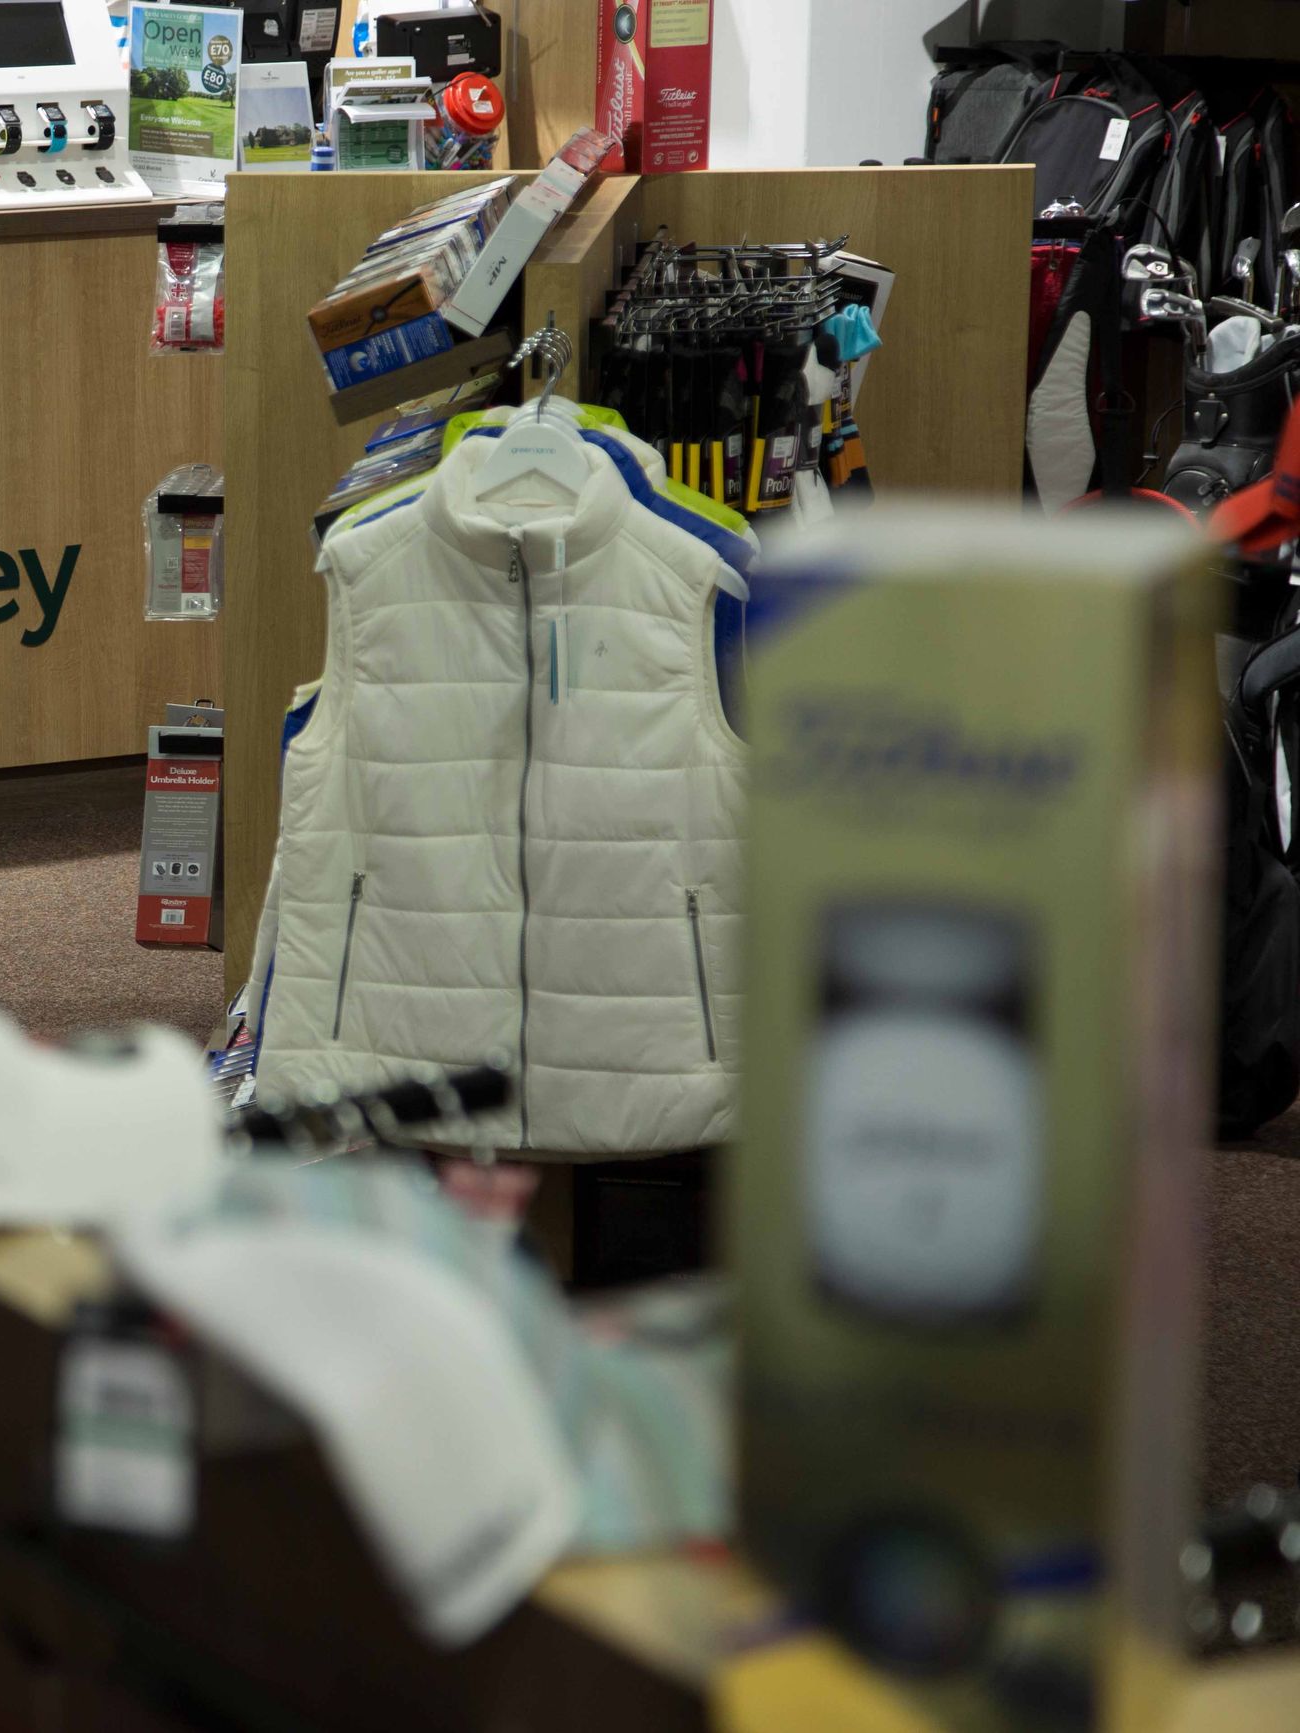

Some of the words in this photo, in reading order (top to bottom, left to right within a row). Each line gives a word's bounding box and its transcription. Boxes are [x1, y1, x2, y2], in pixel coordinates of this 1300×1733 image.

[144, 19, 202, 45] Open
[169, 44, 202, 58] Week
[210, 44, 230, 56] £70
[204, 70, 223, 86] £80
[657, 88, 698, 104] Titleist
[606, 57, 626, 157] Titleist
[140, 113, 170, 123] Everyone
[171, 116, 202, 127] Welcome
[170, 767, 198, 775] Deluxe
[150, 775, 187, 784] Umbrella
[188, 777, 216, 785] Holder
